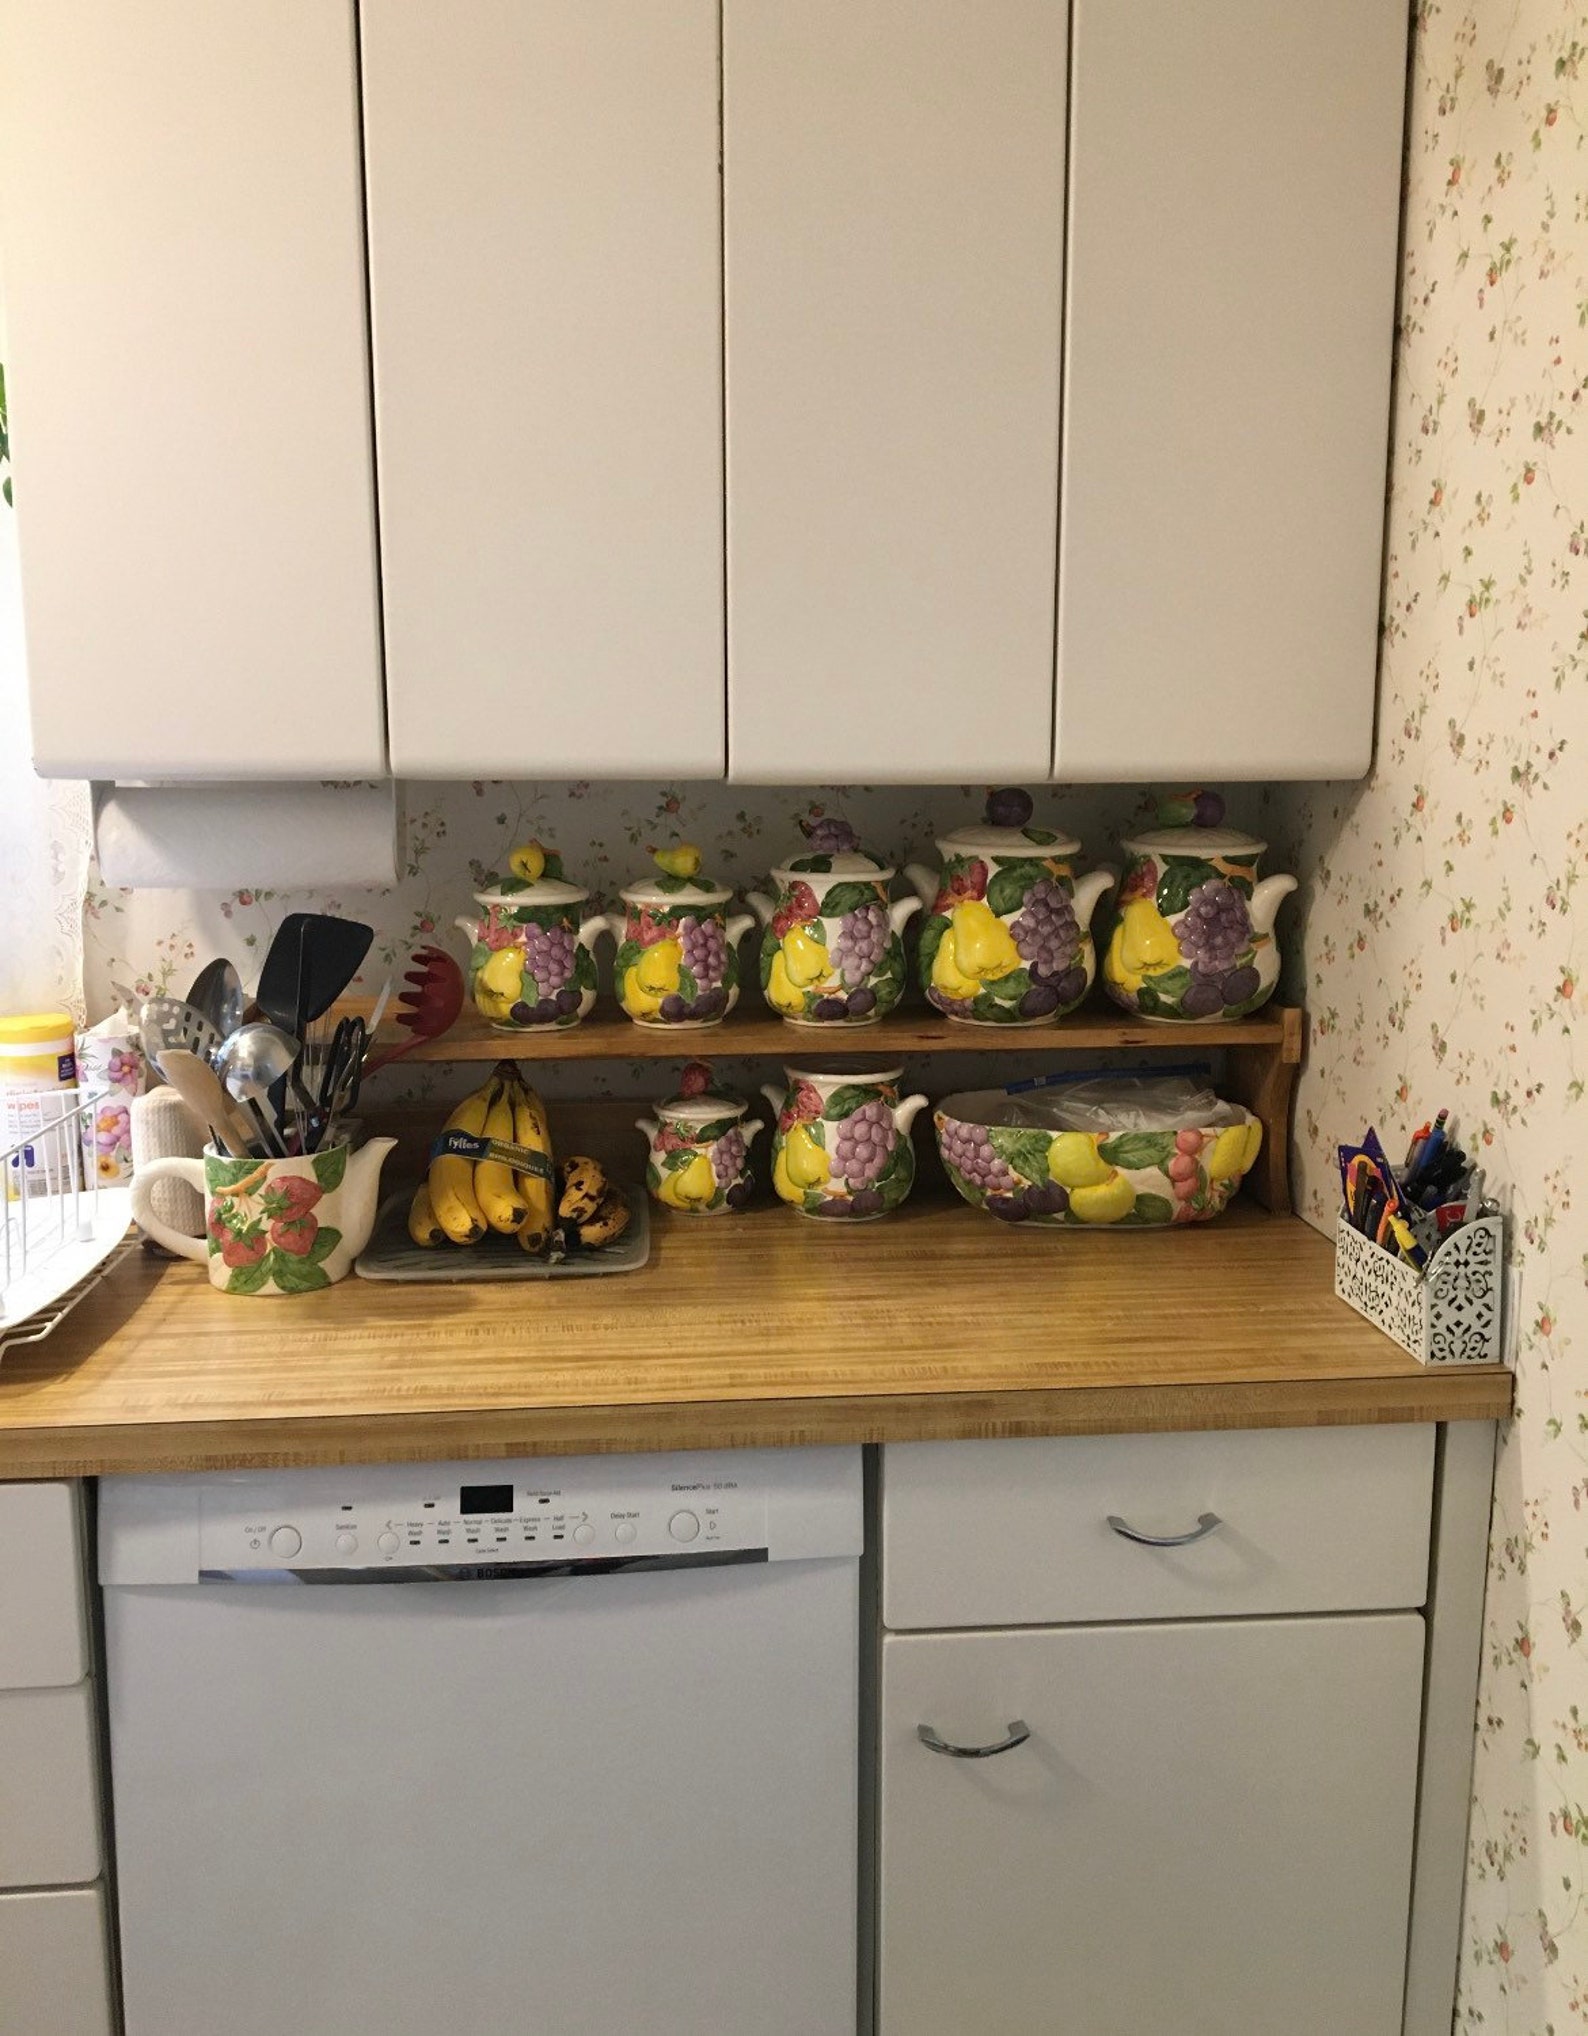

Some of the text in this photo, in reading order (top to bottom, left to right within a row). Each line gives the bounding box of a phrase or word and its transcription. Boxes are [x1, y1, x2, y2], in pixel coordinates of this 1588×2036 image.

[7, 1101, 40, 1111] wpes
[492, 1140, 528, 1154] ORGANIC
[610, 1512, 625, 1520] Delay
[477, 1568, 514, 1578] BOSC
